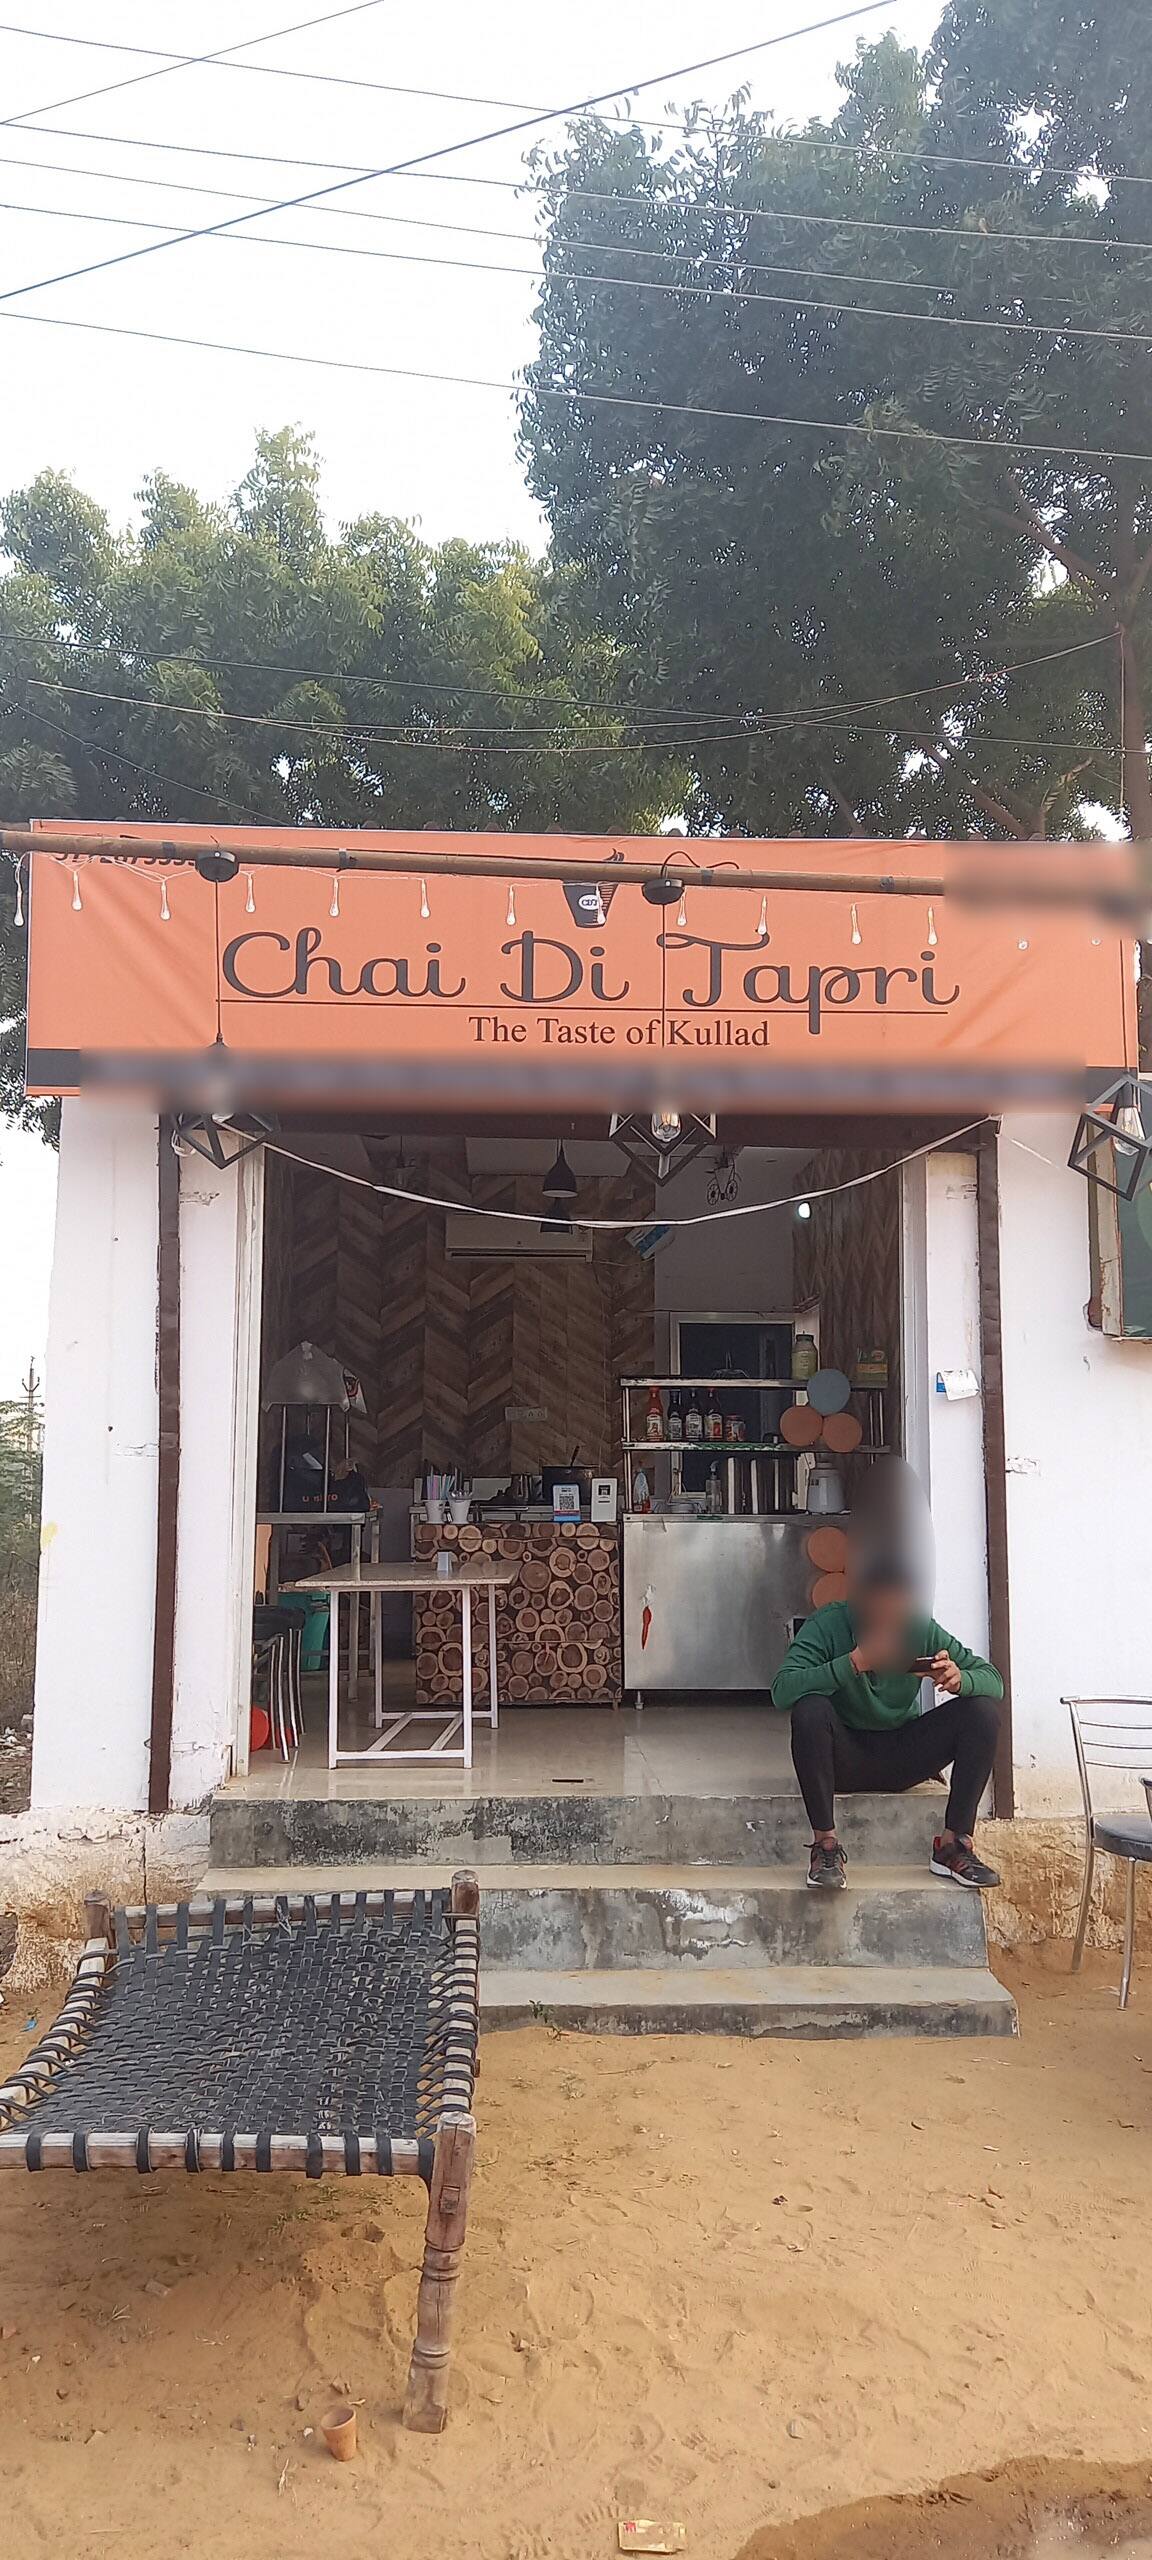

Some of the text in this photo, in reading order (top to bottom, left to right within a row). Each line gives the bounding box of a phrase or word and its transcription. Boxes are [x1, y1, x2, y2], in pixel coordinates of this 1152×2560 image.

[222, 927, 960, 1035] Chai Di Tapri
[469, 1016, 769, 1047] The Taste of Kullad
